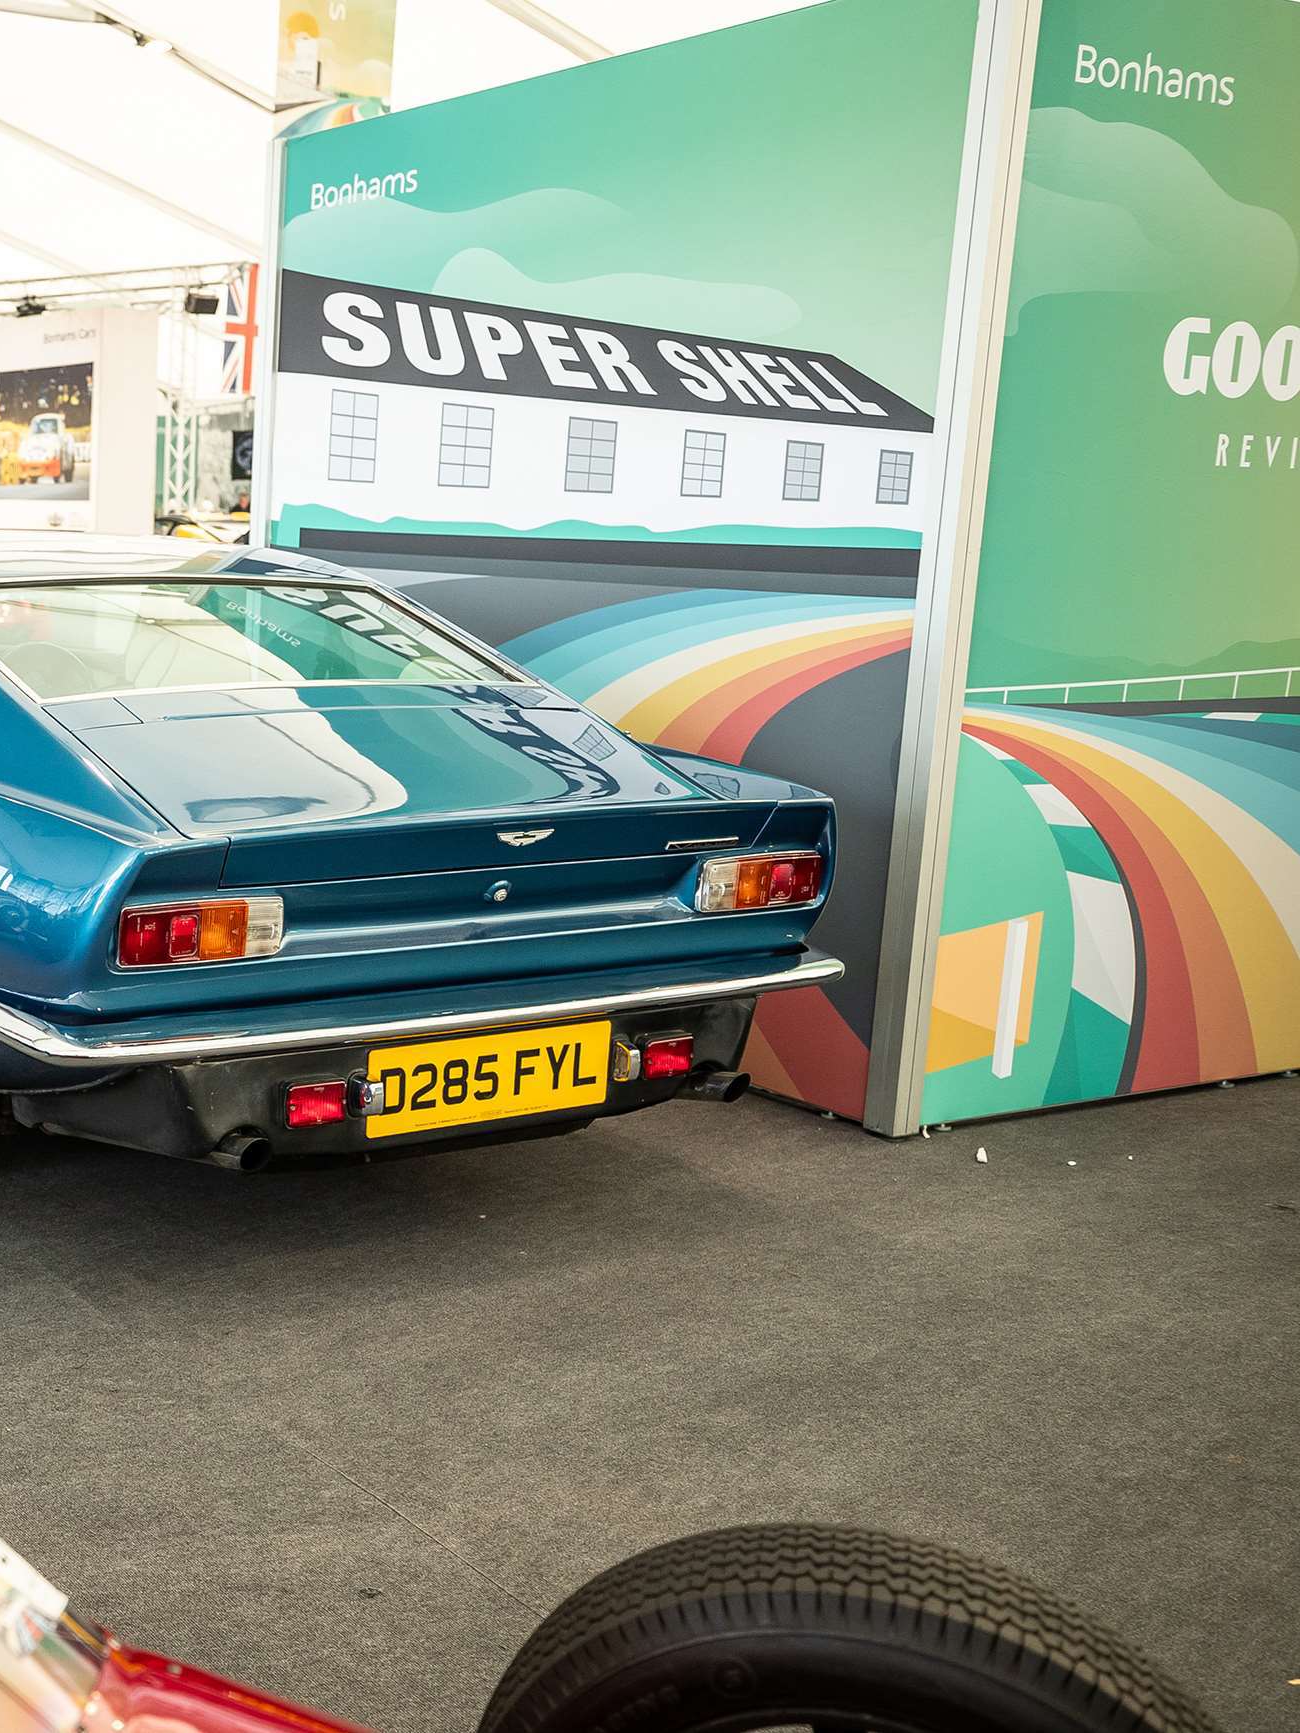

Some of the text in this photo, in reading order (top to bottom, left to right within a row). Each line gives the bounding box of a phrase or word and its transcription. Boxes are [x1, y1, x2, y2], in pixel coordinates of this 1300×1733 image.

[1074, 44, 1235, 106] Bonhams
[310, 169, 418, 210] Bonhams
[321, 292, 889, 416] SUPER SHELL
[380, 1042, 597, 1116] D285 FYL
